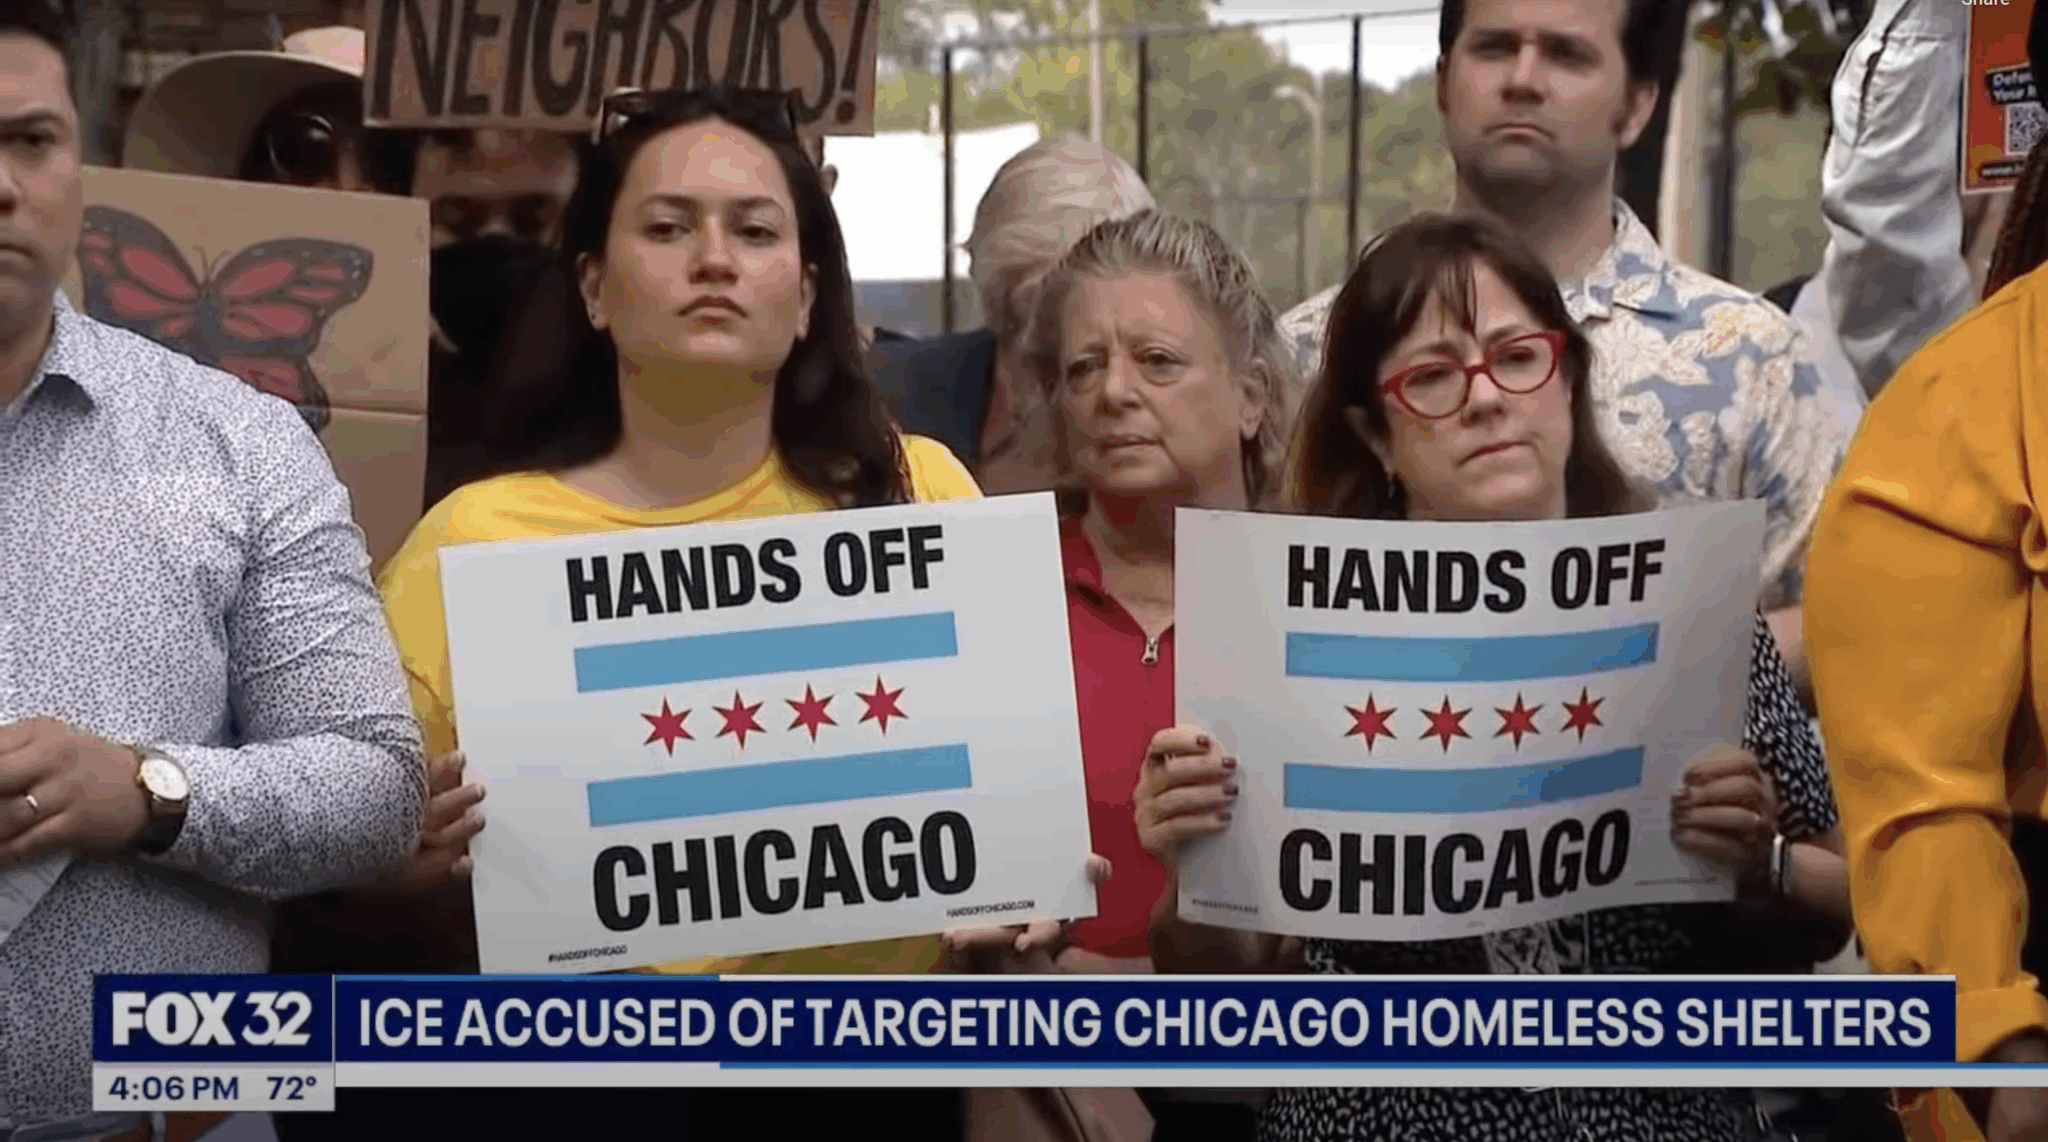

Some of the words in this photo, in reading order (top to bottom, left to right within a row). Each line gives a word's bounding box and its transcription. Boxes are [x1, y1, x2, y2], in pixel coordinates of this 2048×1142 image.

[566, 538, 802, 623] HANDS
[824, 524, 945, 598] OFF
[1286, 544, 1527, 614] HANDS
[1551, 538, 1666, 610] OFF
[592, 810, 978, 932] CHICAGO
[1279, 808, 1632, 916] CHICAGO
